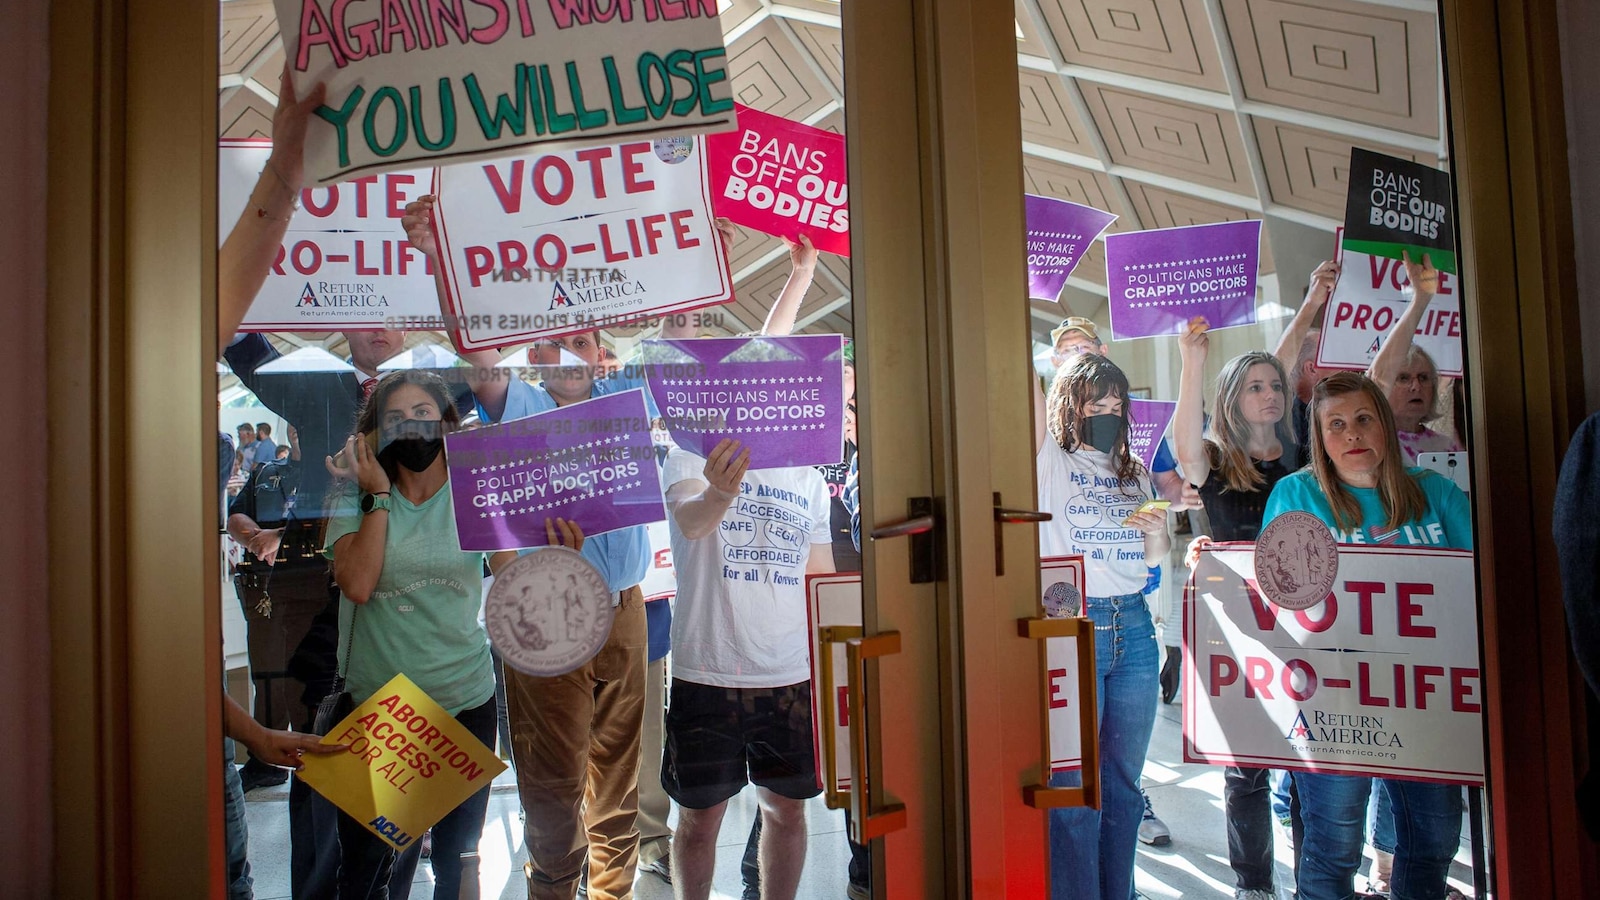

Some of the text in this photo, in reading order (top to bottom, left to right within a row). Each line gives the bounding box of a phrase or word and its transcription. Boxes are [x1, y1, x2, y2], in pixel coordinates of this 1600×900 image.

[312, 47, 734, 168] YOU WILL LOSE
[740, 129, 827, 174] BANS
[482, 142, 655, 214] VOTE
[731, 154, 848, 206] OFF OU
[1373, 169, 1421, 196] BANS
[301, 174, 415, 218] OTE
[723, 175, 849, 233] BODIES
[1370, 188, 1446, 224] OFF OUR
[1369, 206, 1439, 240] BODIES
[268, 240, 434, 275] RO-LIF
[464, 209, 700, 287] PRO-LIFE
[1027, 254, 1073, 266] OCTORS
[1047, 242, 1075, 254] MAKE
[1124, 275, 1248, 300] CRAPPY DOCTORS
[1128, 263, 1245, 285] POLITICIANS MAKE
[295, 282, 389, 307] AMERICA
[547, 280, 646, 311] AMERICA
[667, 389, 820, 404] POLITICIANS MAKE
[667, 404, 825, 421] CRAPPY DOCTORS
[477, 458, 579, 491] POLITICIANS
[586, 447, 631, 469] MAKE
[817, 466, 844, 481] OFF
[472, 461, 640, 508] CRAPPY DOCTORS
[757, 484, 809, 511] ABORTION
[740, 502, 810, 531] ACCESSIBLE
[1069, 505, 1099, 515] SAFE
[1111, 508, 1134, 517] LEG
[721, 521, 753, 532] SAFE
[769, 523, 798, 547] LEGAL
[1074, 529, 1145, 541] AFFORDABLE
[1404, 522, 1443, 545] LIF
[728, 549, 801, 565] AFFORDABLE
[1092, 548, 1103, 560] all
[1117, 548, 1145, 561] foreve
[429, 578, 447, 586] FOR
[723, 566, 740, 580] for
[744, 569, 758, 581] all
[1243, 577, 1436, 638] VOTE
[1209, 654, 1481, 713] PRO-LIFE
[1284, 709, 1404, 748] AMERICA
[1313, 710, 1383, 729] RETURN
[356, 712, 440, 779] ACCESS
[378, 694, 484, 782] ABORTION
[337, 727, 415, 795] FOR ALL
[1291, 744, 1397, 760] ReturnAmerica.org
[369, 815, 413, 847] ACLU
